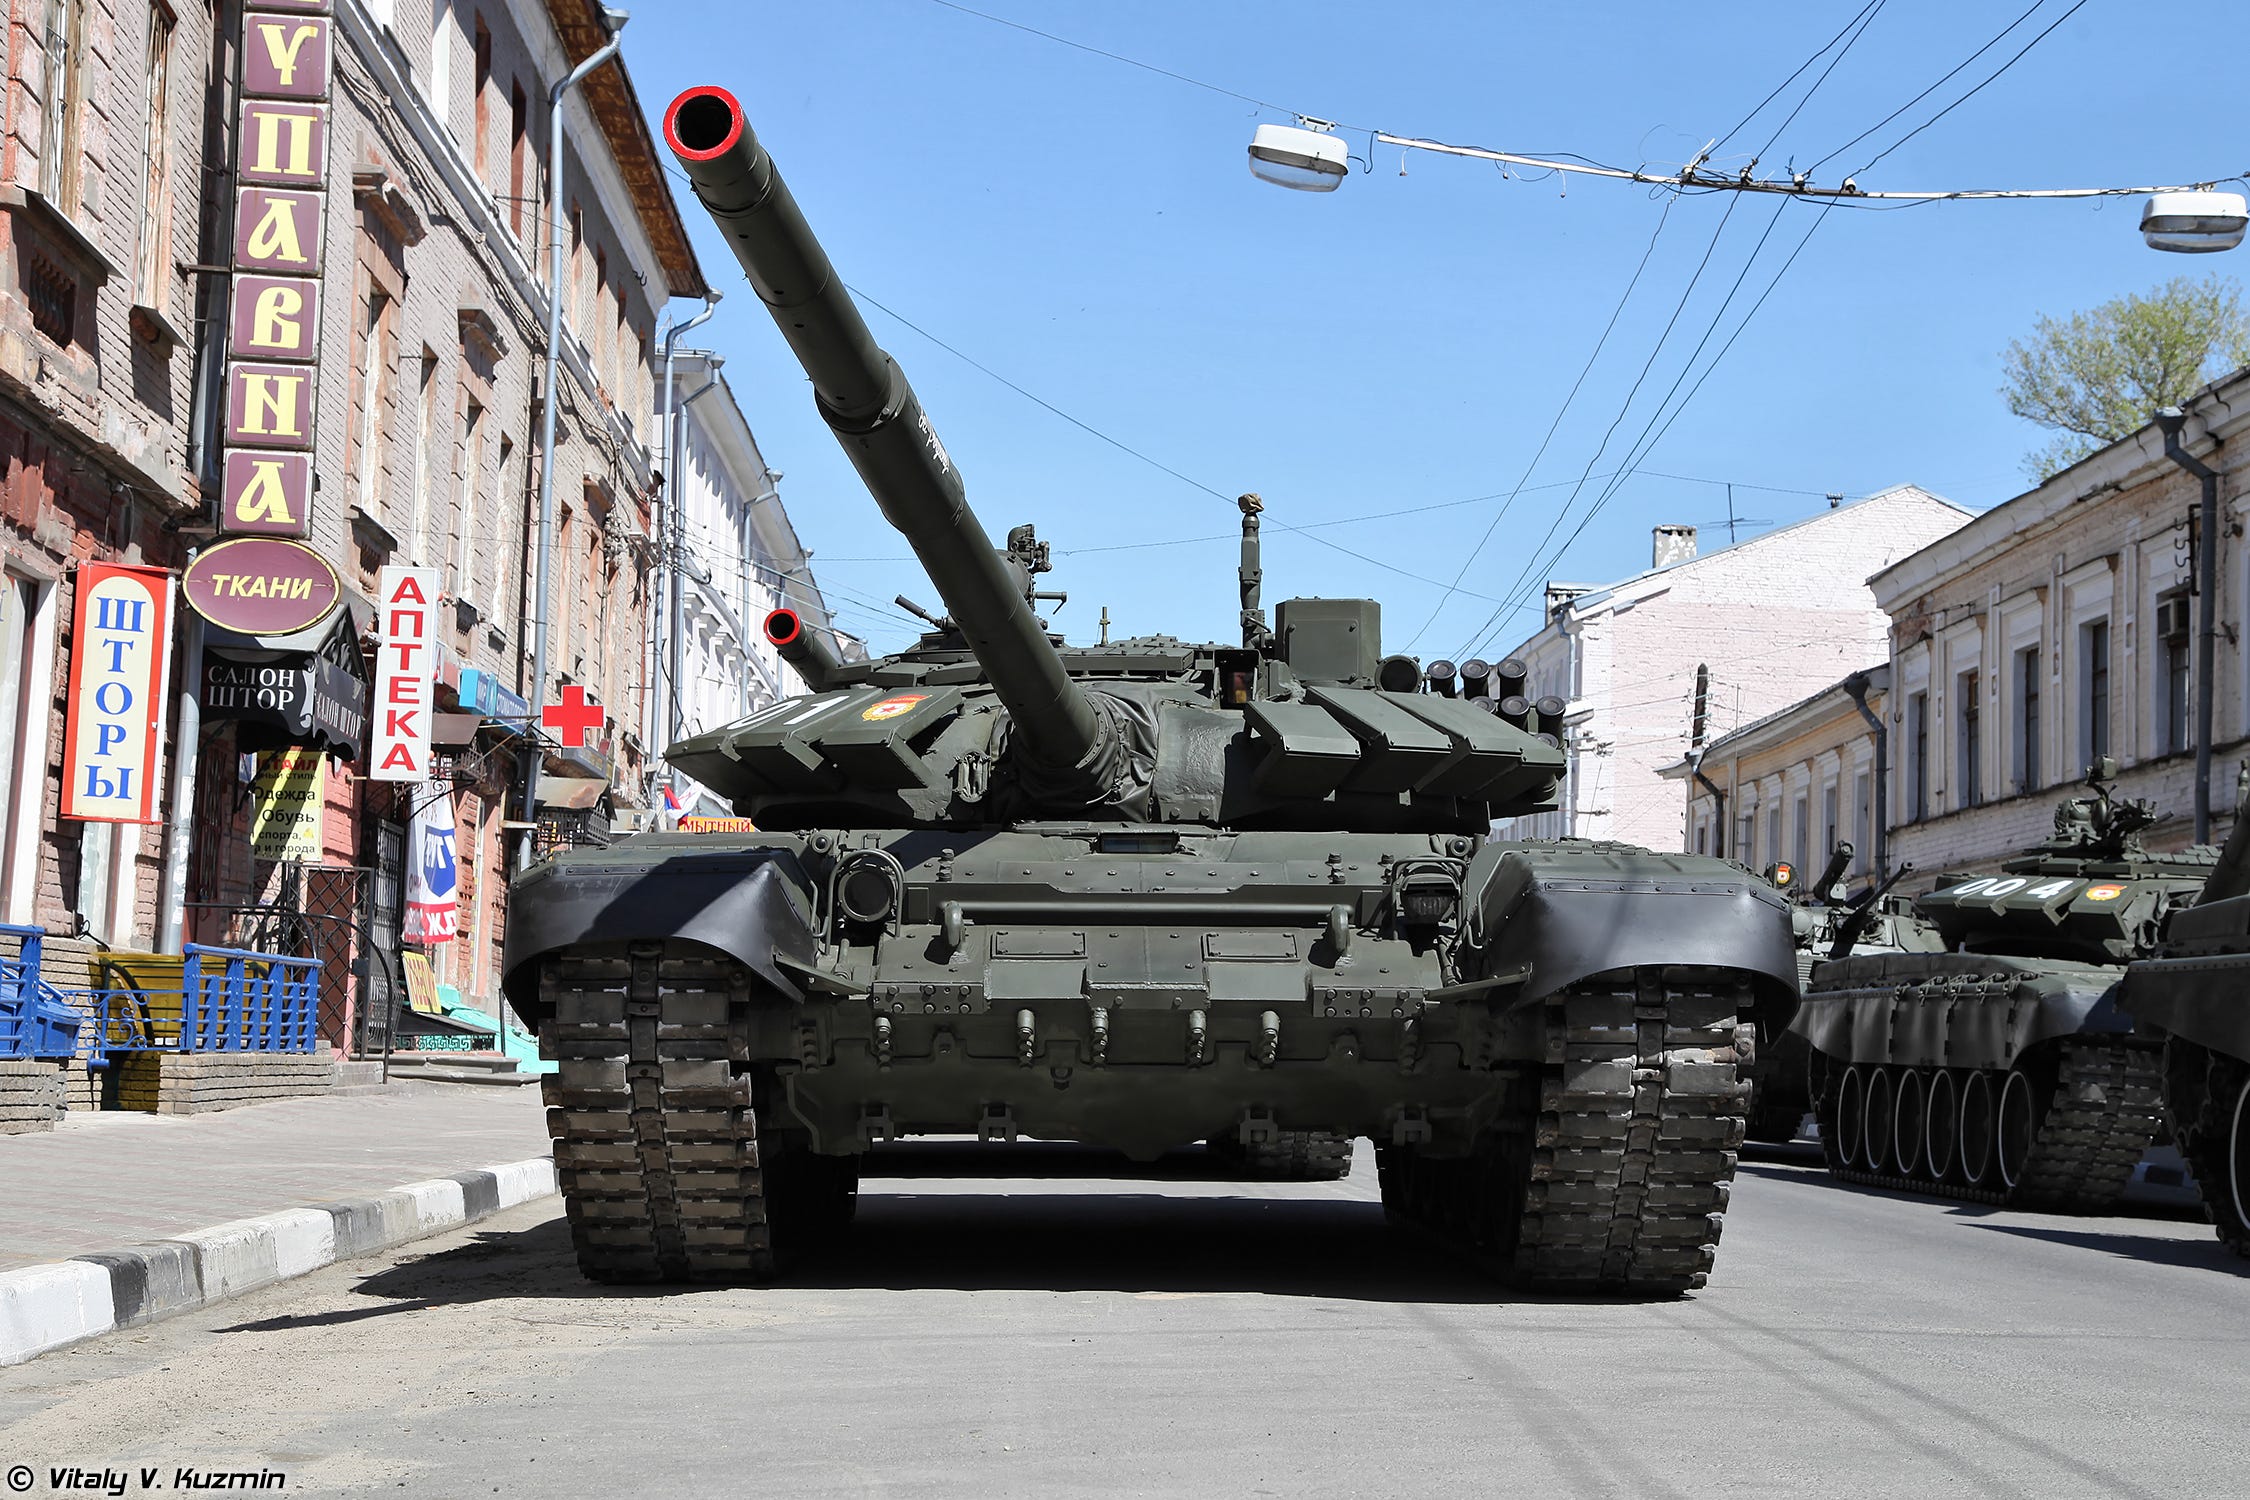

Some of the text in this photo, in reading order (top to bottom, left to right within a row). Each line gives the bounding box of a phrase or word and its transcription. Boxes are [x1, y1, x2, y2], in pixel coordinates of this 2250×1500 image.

[235, 0, 319, 524] УПАВНА
[211, 574, 313, 600] ТКАНИ
[208, 665, 295, 688] САЛОН
[380, 577, 427, 772] АПТЕКА
[83, 596, 147, 800] ШТОРЫ
[208, 686, 295, 710] ШТОР
[316, 692, 361, 739] САЛОН ШТОР
[253, 786, 315, 802] Одежда
[262, 809, 315, 825] Обувь
[683, 820, 751, 832] МЫТНЫЙ
[258, 831, 302, 841] спорта,
[275, 844, 315, 853] города
[1953, 878, 2073, 898] 004
